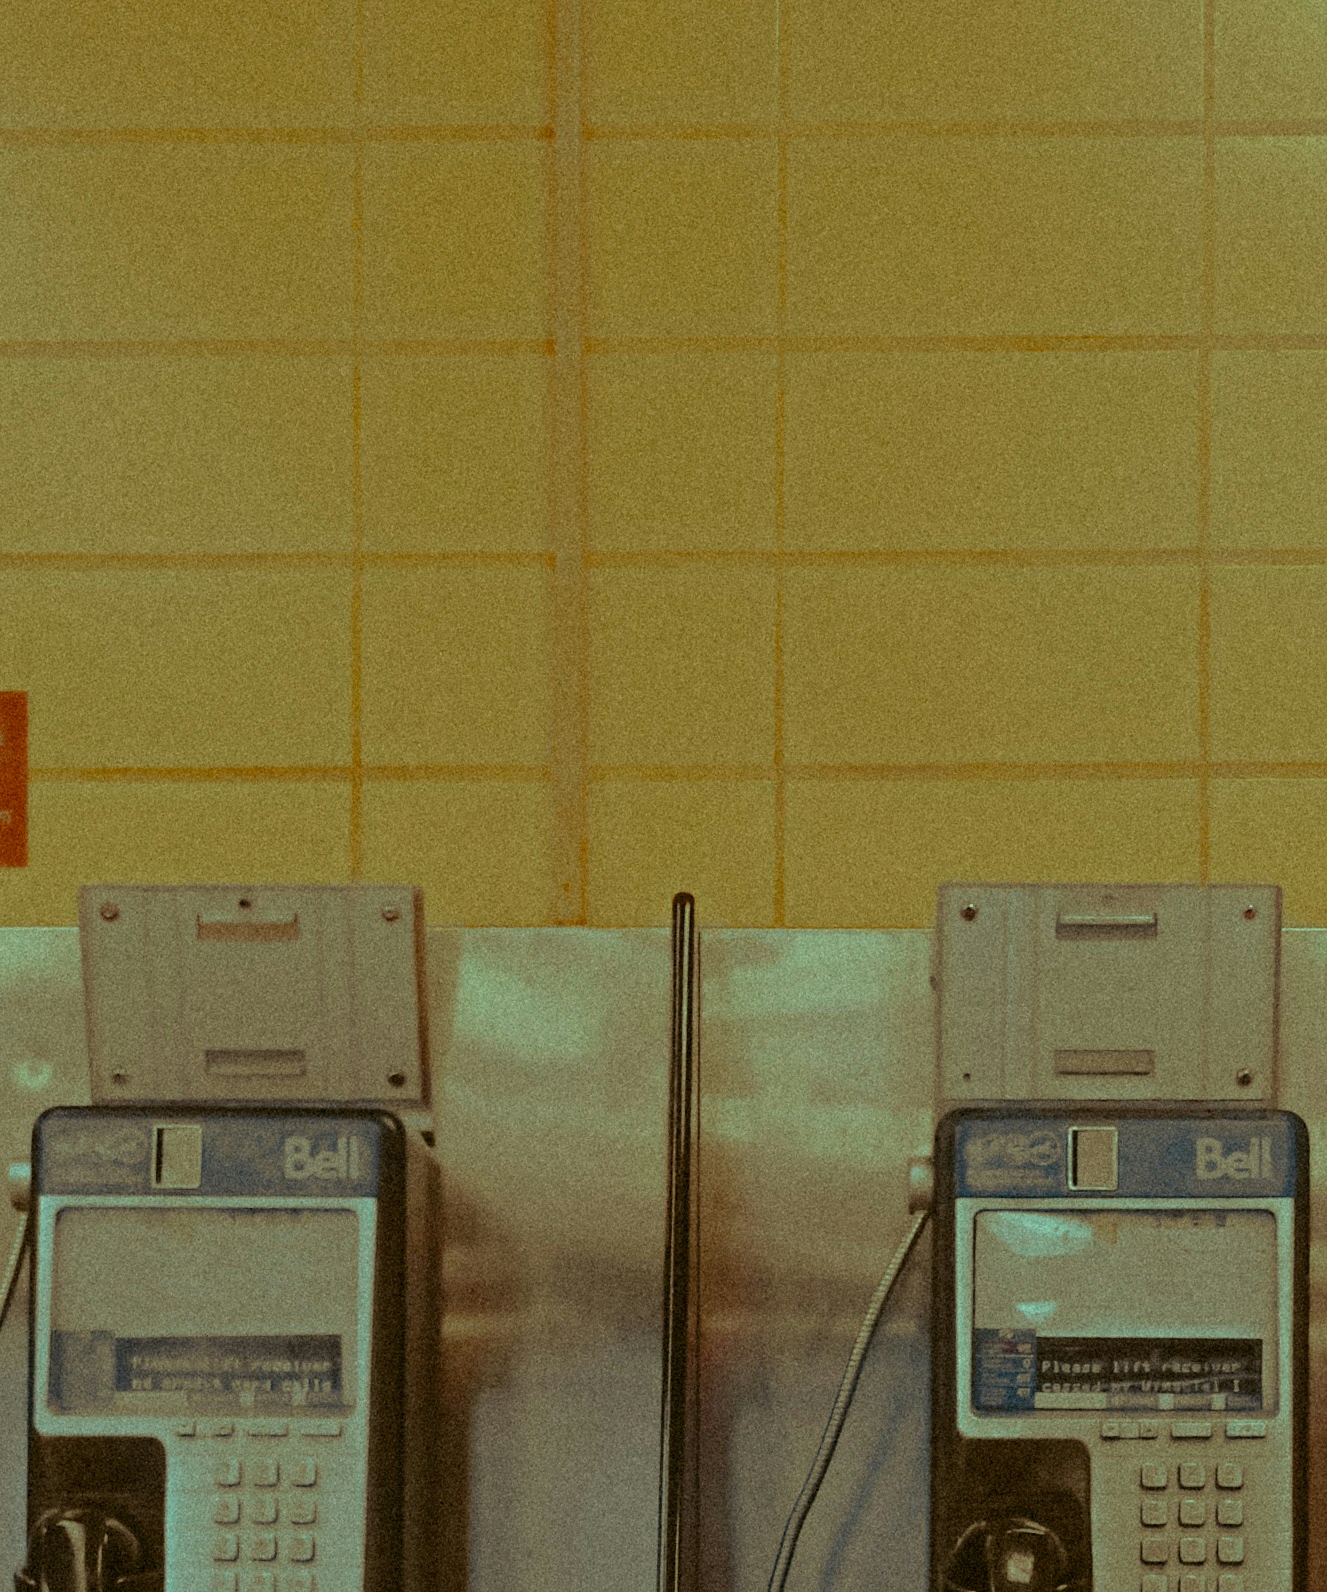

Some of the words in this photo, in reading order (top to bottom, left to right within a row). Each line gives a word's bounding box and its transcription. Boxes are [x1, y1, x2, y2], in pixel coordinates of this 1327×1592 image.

[282, 1134, 359, 1181] Bell
[1195, 1136, 1273, 1181] Bell
[1041, 1360, 1101, 1374] Please
[1113, 1360, 1151, 1373] lift
[1162, 1360, 1241, 1373] receiver
